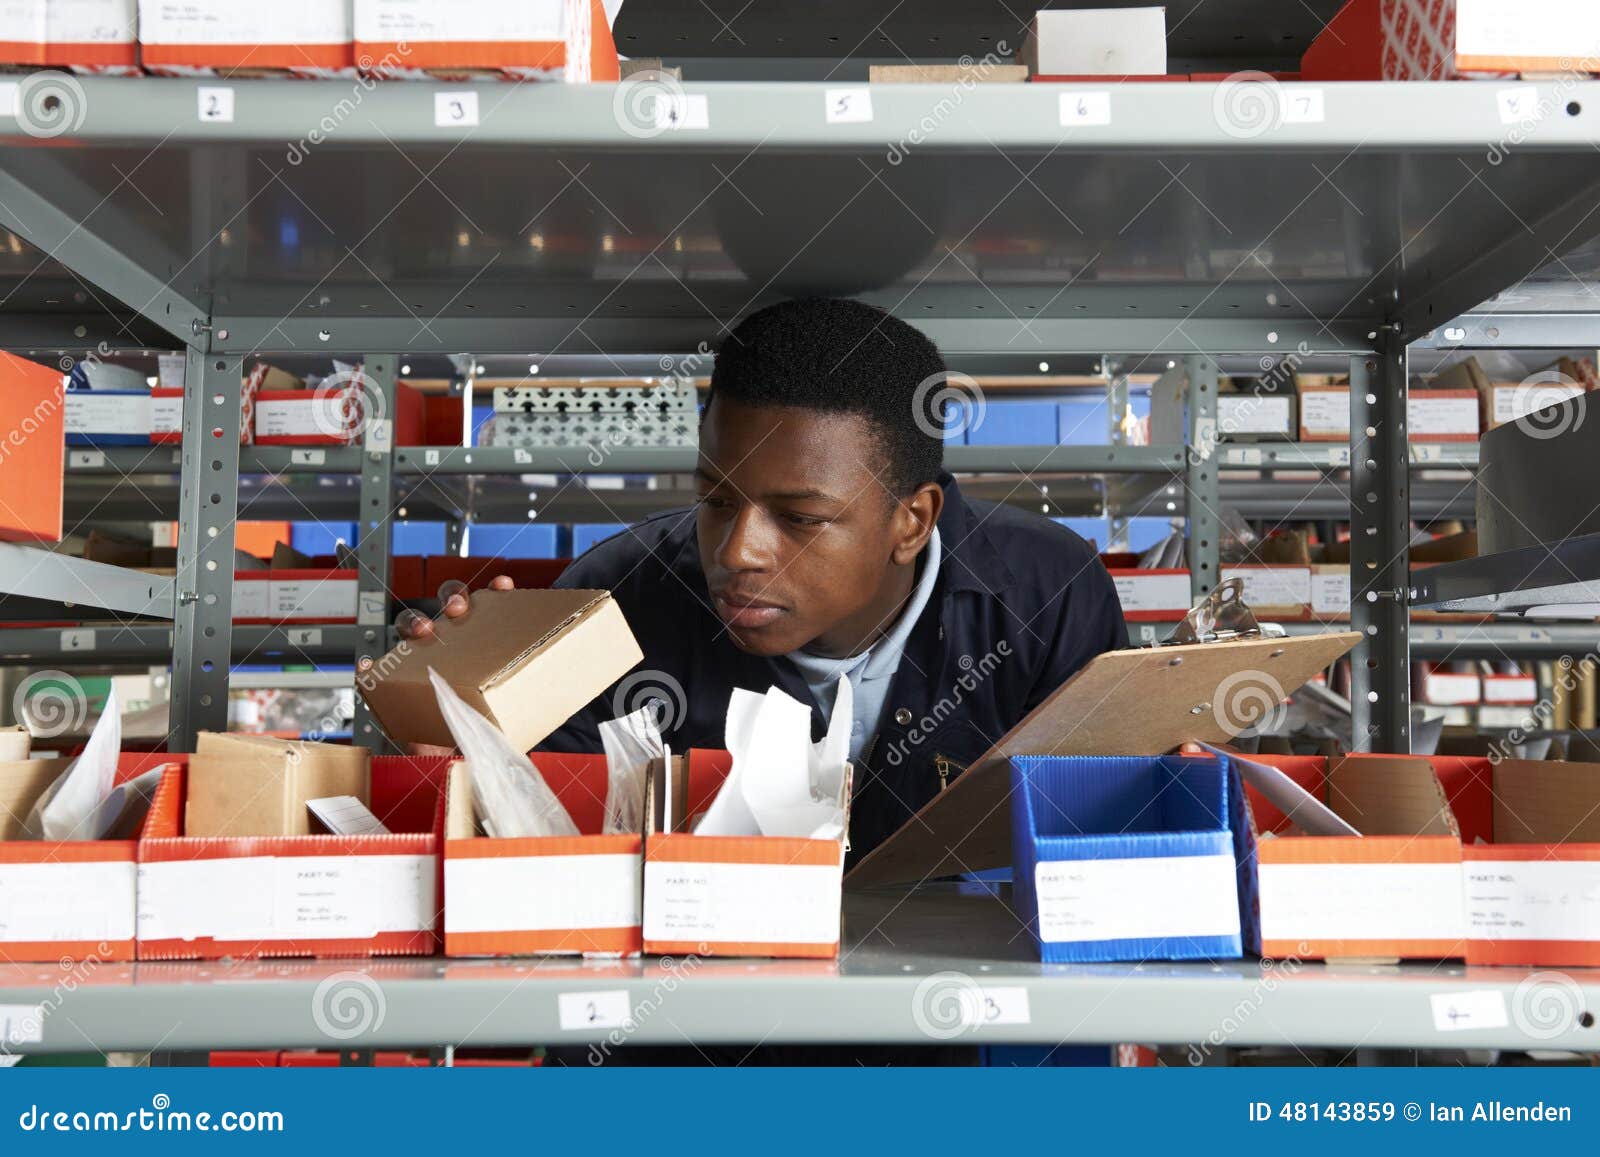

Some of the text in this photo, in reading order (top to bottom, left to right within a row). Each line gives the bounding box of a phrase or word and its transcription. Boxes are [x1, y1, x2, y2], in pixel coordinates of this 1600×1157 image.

[206, 95, 221, 116] 2
[834, 95, 851, 115] 5
[1076, 98, 1088, 117] 6
[1295, 97, 1311, 115] 7
[71, 635, 80, 648] 6
[586, 1000, 604, 1022] 2
[984, 998, 1001, 1021] 3
